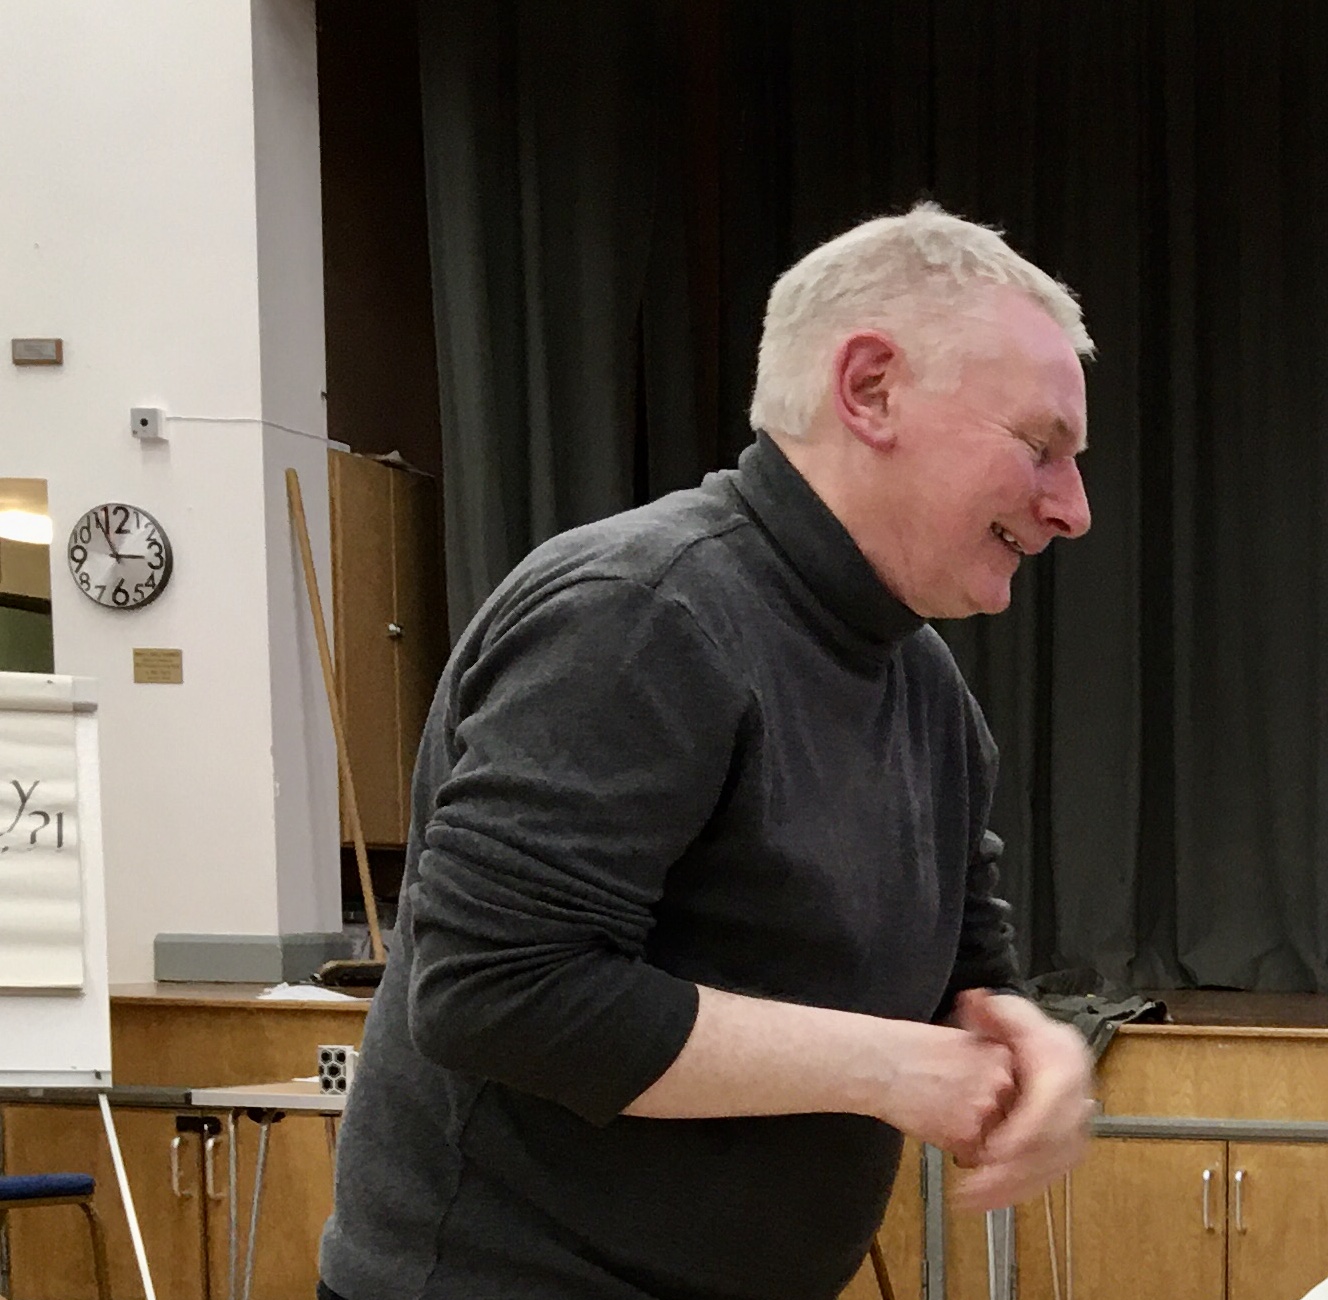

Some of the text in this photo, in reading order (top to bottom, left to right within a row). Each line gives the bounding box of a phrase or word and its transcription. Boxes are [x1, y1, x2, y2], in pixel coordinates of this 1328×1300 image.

[101, 506, 131, 535] 12
[133, 511, 140, 529] 1
[144, 522, 157, 541] 2
[70, 545, 88, 573] 9
[147, 541, 164, 570] 3
[79, 572, 91, 591] 8
[144, 571, 156, 589] 4
[94, 585, 107, 601] 7
[112, 578, 130, 606] 6
[133, 583, 145, 602] 5
